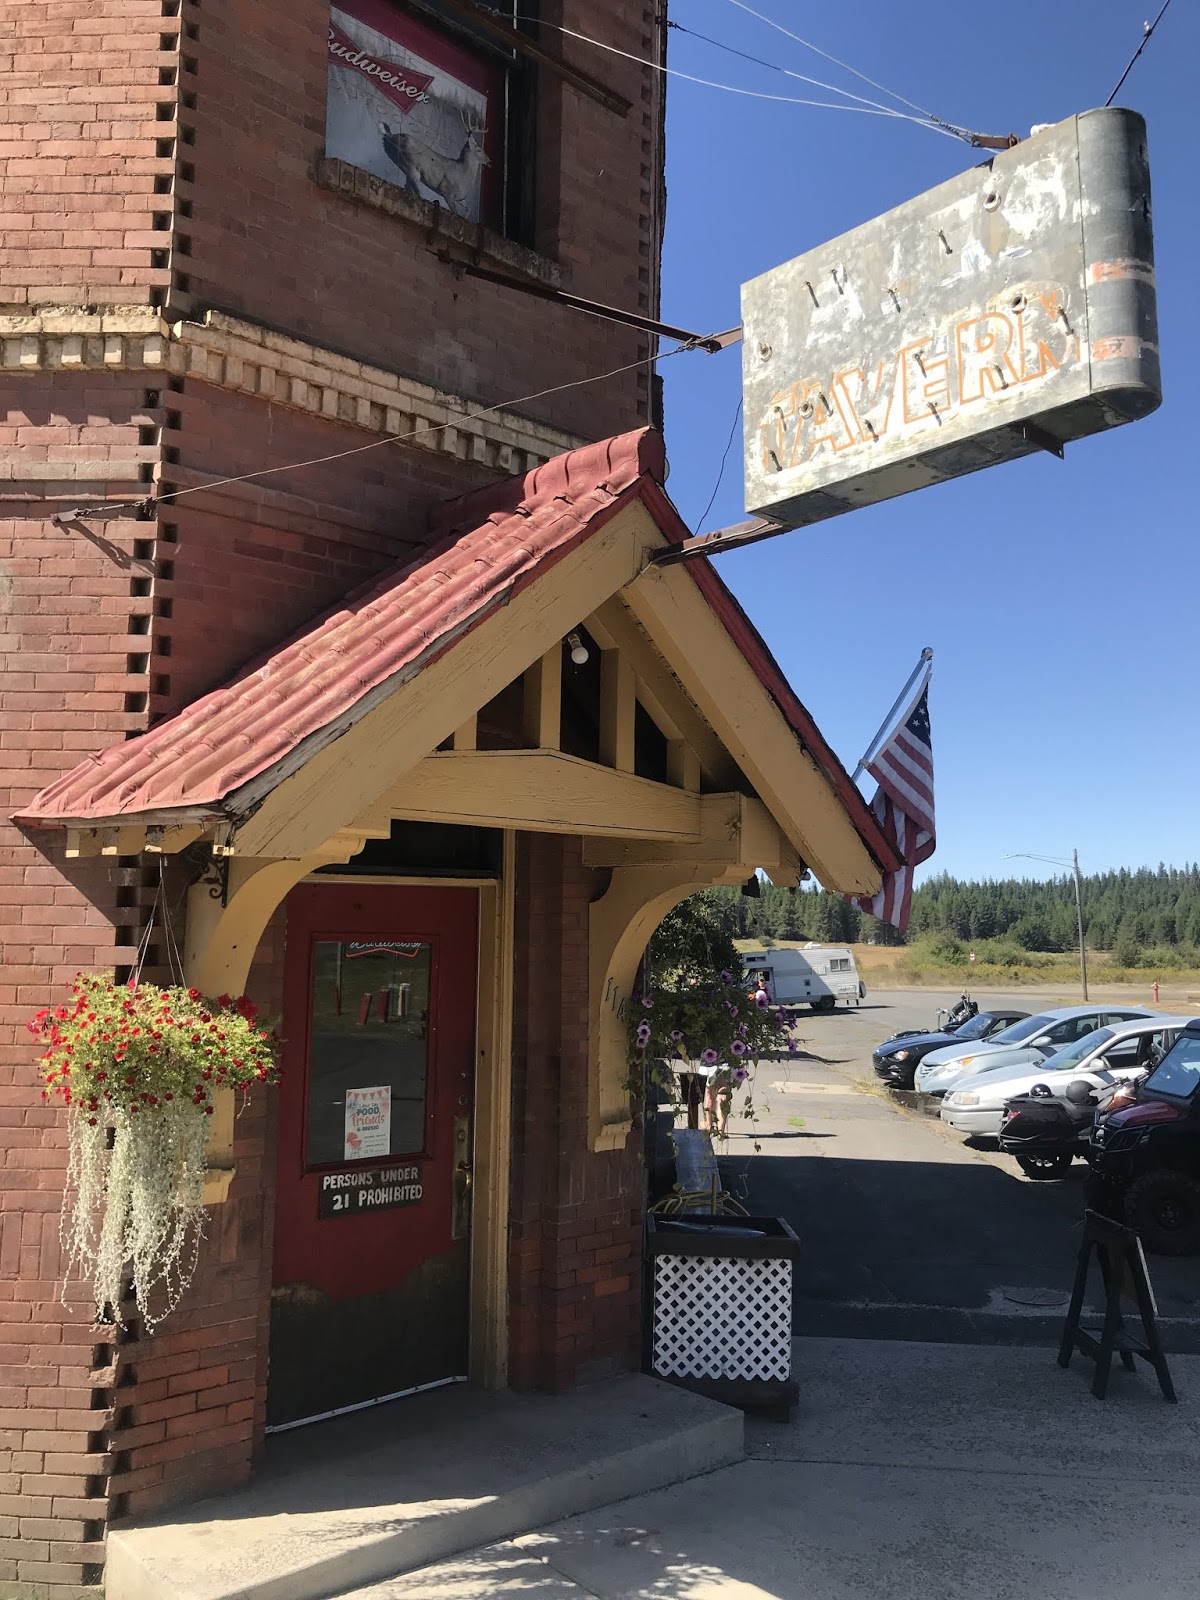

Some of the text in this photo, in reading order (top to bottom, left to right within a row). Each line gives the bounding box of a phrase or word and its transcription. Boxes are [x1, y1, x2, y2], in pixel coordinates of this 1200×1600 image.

[757, 288, 1081, 470] TAVERN
[322, 1166, 419, 1190] PERSONS UNDER
[332, 1184, 423, 1210] 21 PROHIBITED
